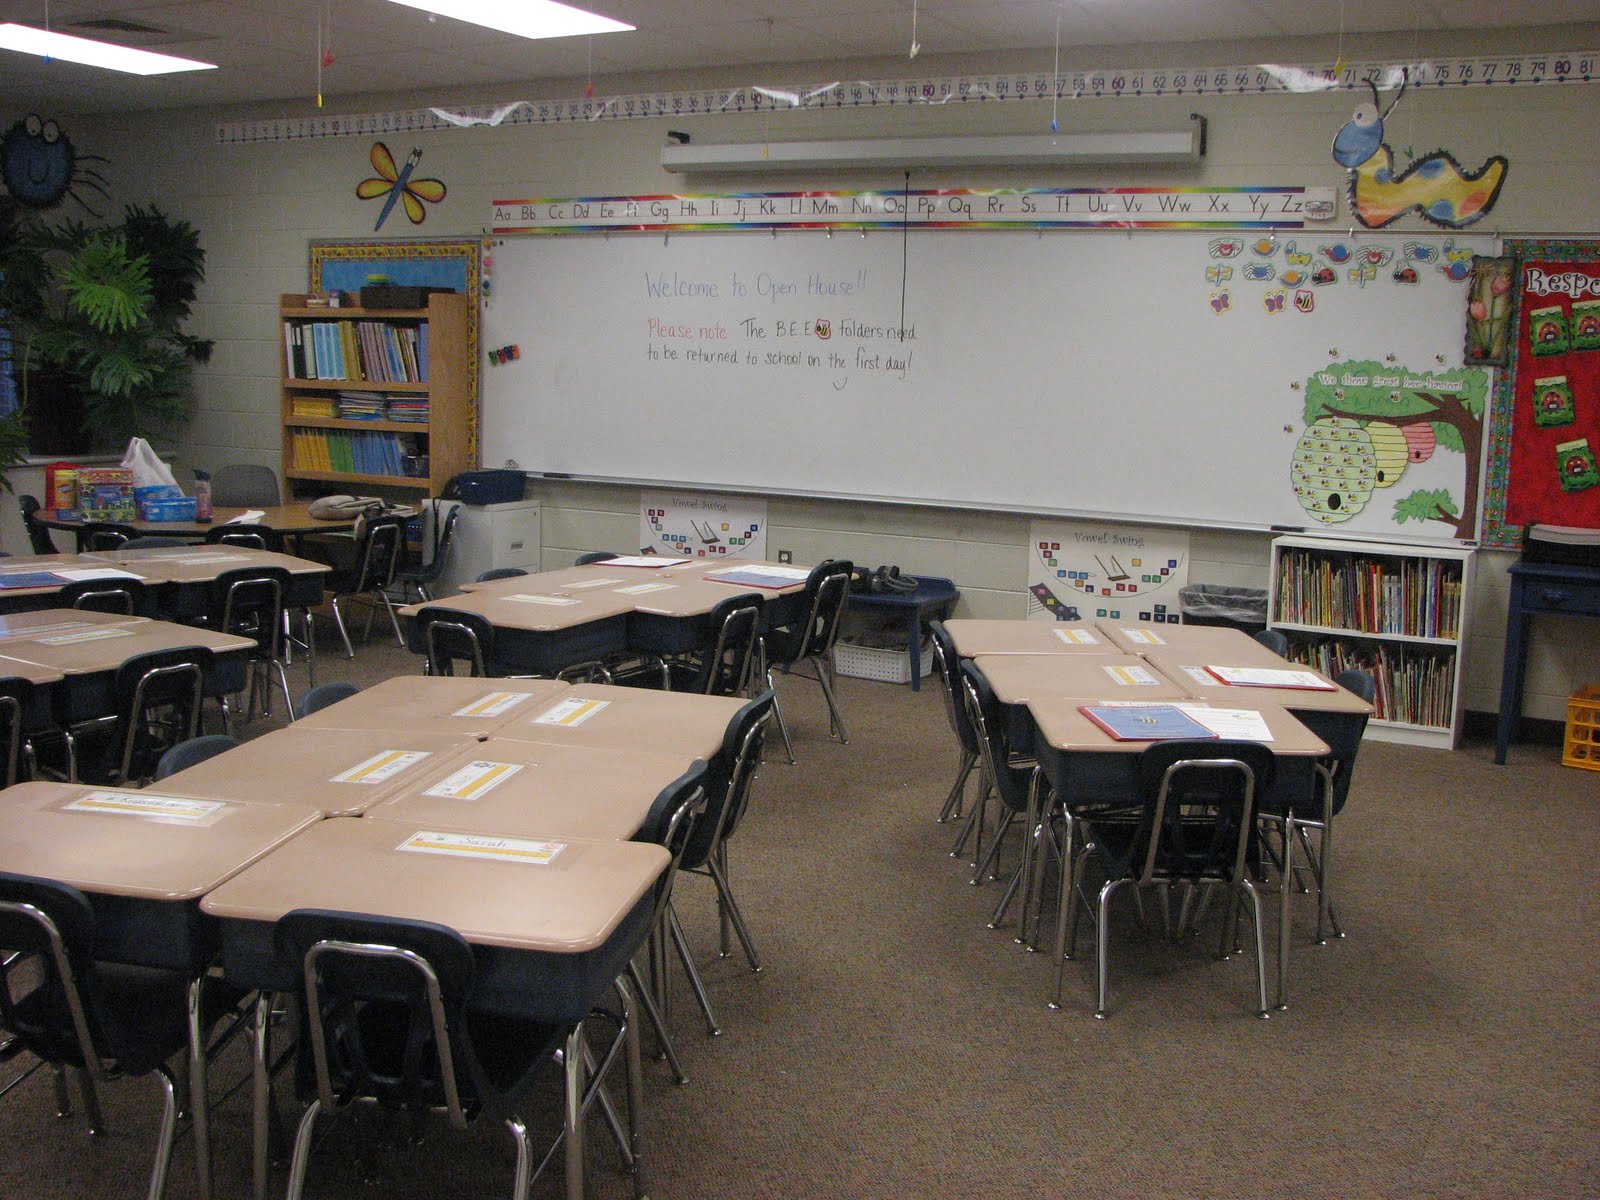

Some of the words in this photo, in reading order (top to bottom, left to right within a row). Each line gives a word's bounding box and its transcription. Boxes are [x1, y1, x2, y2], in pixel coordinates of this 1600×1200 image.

[640, 99, 650, 109] 33
[656, 99, 666, 109] 34
[672, 98, 682, 108] 35
[688, 97, 698, 107] 36
[704, 96, 714, 106] 37
[735, 94, 745, 104] 39
[751, 93, 762, 104] 40
[833, 89, 845, 99] 45
[851, 88, 862, 99] 46
[868, 87, 879, 98] 47
[887, 86, 898, 97] 48
[905, 86, 917, 96] 49
[922, 85, 935, 96] 50
[940, 84, 951, 95] 51
[959, 83, 971, 94] 52
[996, 81, 1009, 93] 54
[1015, 81, 1028, 92] 55
[1034, 80, 1047, 92] 56
[1073, 79, 1085, 90] 58
[1092, 78, 1104, 89] 59
[1111, 77, 1125, 89] 60
[1132, 77, 1143, 88] 61
[1153, 76, 1166, 88] 62
[1173, 75, 1186, 87] 63
[1194, 74, 1207, 87] 64
[1214, 73, 1227, 86] 65
[1235, 73, 1248, 85] 66
[1256, 72, 1269, 84] 67
[1322, 70, 1336, 81] 70
[1344, 69, 1356, 82] 71
[1366, 69, 1381, 81] 72
[1435, 65, 1449, 79] 75
[1458, 65, 1473, 78] 76
[1482, 64, 1497, 77] 77
[1506, 63, 1521, 76] 78
[1530, 62, 1546, 75] 79
[1554, 60, 1571, 74] 80
[1579, 60, 1593, 73] 81
[495, 207, 511, 221] Aa
[521, 205, 536, 220] Bb
[549, 204, 564, 219] Cc
[573, 203, 589, 218] Dd
[600, 203, 614, 218] Ee
[650, 201, 669, 222] Gg
[680, 200, 697, 216] Hh
[711, 200, 719, 216] Ii
[733, 200, 746, 222] Jj
[760, 199, 776, 215] Kk
[812, 198, 839, 214] Mm
[852, 198, 872, 214] Nn
[883, 197, 905, 213] Oo
[918, 197, 935, 220] Pp
[948, 196, 973, 220] Qq
[988, 196, 1004, 213] Rr
[1021, 196, 1037, 213] Ss
[1055, 195, 1069, 213] Tt
[1088, 195, 1108, 212] Uu
[1122, 195, 1143, 212] Vv
[1158, 195, 1191, 212] Ww
[1208, 195, 1230, 212] Xx
[1248, 195, 1269, 220] Yy
[1281, 194, 1303, 213] Zz
[645, 271, 719, 298] Welcome
[732, 273, 747, 297] to
[757, 273, 797, 304] Open
[807, 268, 867, 297] House!!
[648, 318, 693, 339] Please
[700, 320, 728, 339] note
[740, 317, 766, 339] The
[887, 323, 918, 340] need
[648, 348, 659, 361] to
[664, 347, 678, 361] be
[686, 347, 739, 364] returned
[746, 351, 758, 365] to
[764, 350, 801, 366] school
[807, 353, 821, 367] on
[828, 352, 847, 369] the
[856, 346, 880, 370] first
[885, 350, 913, 380] day!
[1319, 374, 1337, 386] We
[1342, 373, 1368, 386] show
[672, 498, 698, 509] Vowel
[1075, 532, 1108, 544] Vowel
[1112, 534, 1145, 549] Swing
[460, 836, 506, 848] Sarah
